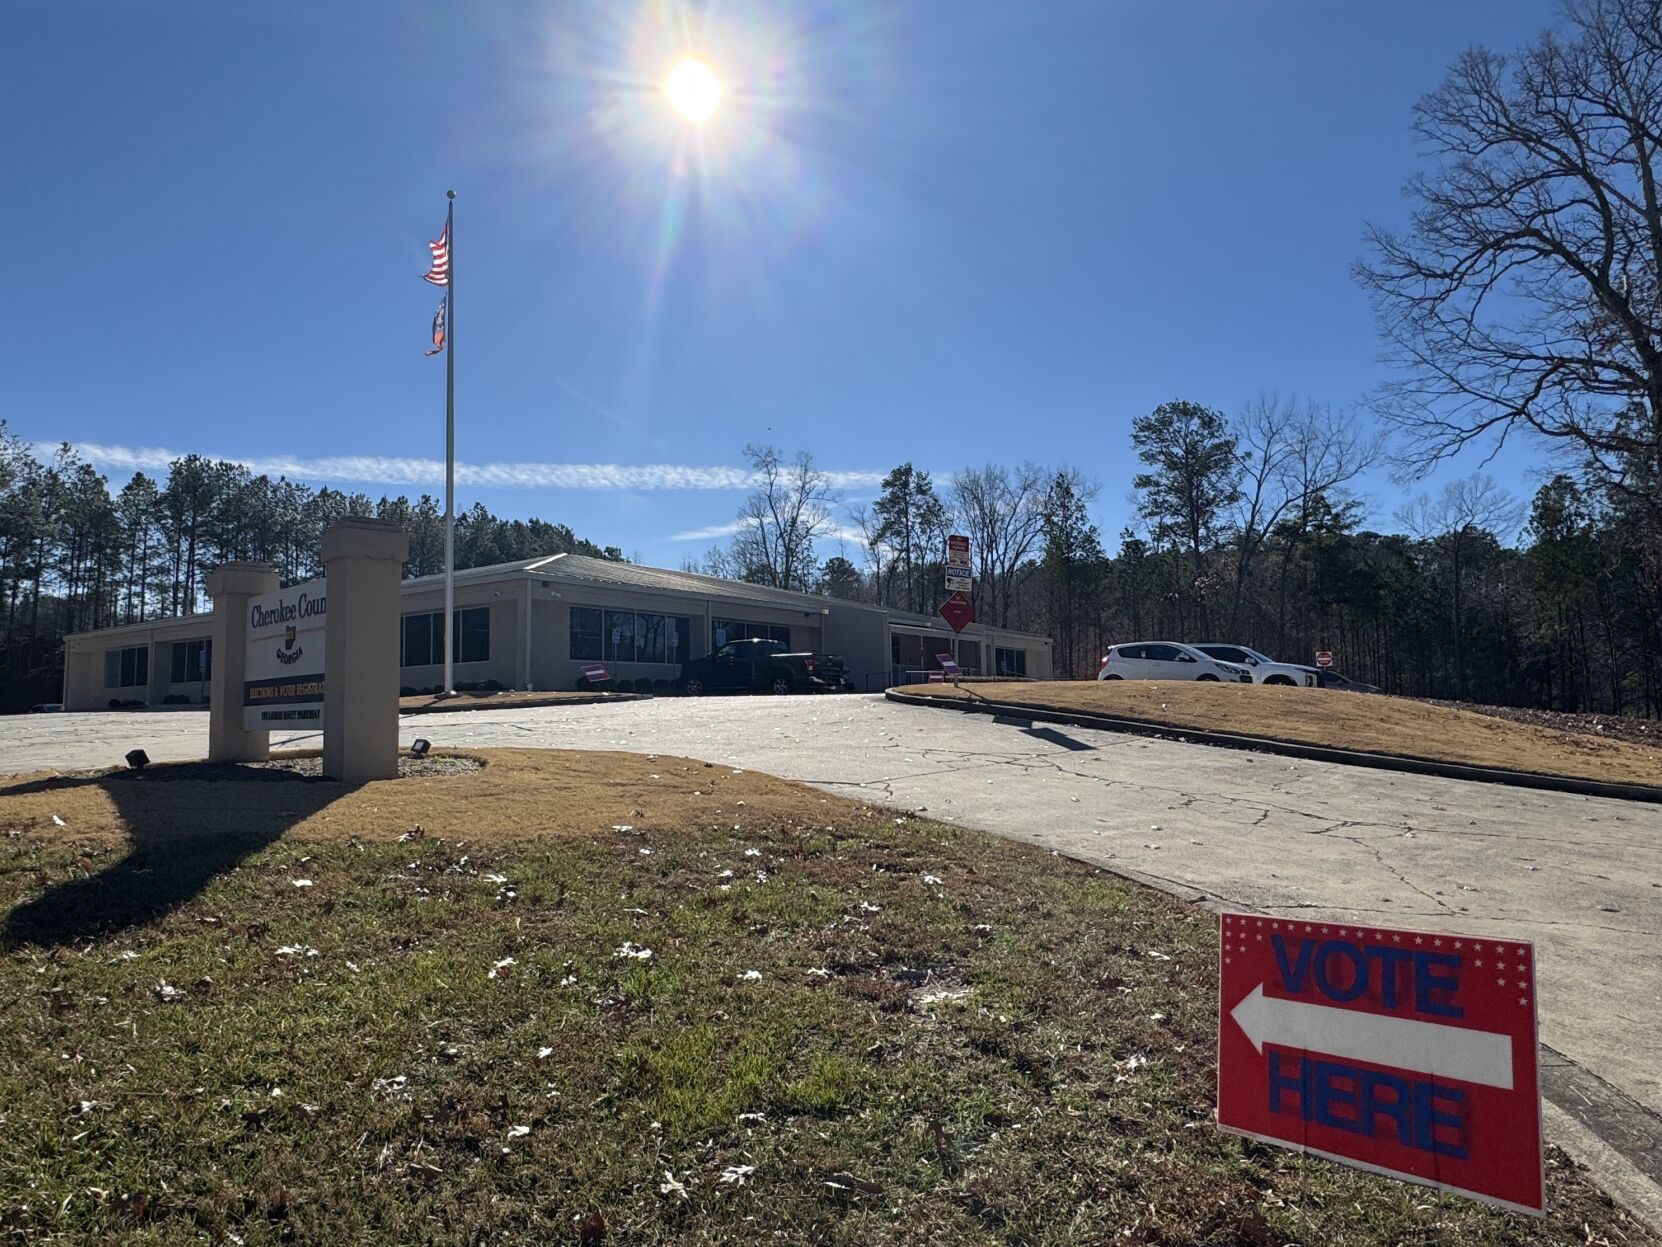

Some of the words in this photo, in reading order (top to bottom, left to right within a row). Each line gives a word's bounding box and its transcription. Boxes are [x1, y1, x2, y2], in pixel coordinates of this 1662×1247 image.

[947, 568, 970, 577] NOTICE
[251, 598, 296, 628] Cherokee
[298, 593, 327, 618] Coun
[277, 646, 303, 664] GEORGIA
[296, 681, 325, 696] REGISTRA
[1270, 934, 1464, 1019] VOTE
[1268, 1051, 1469, 1160] HERE
